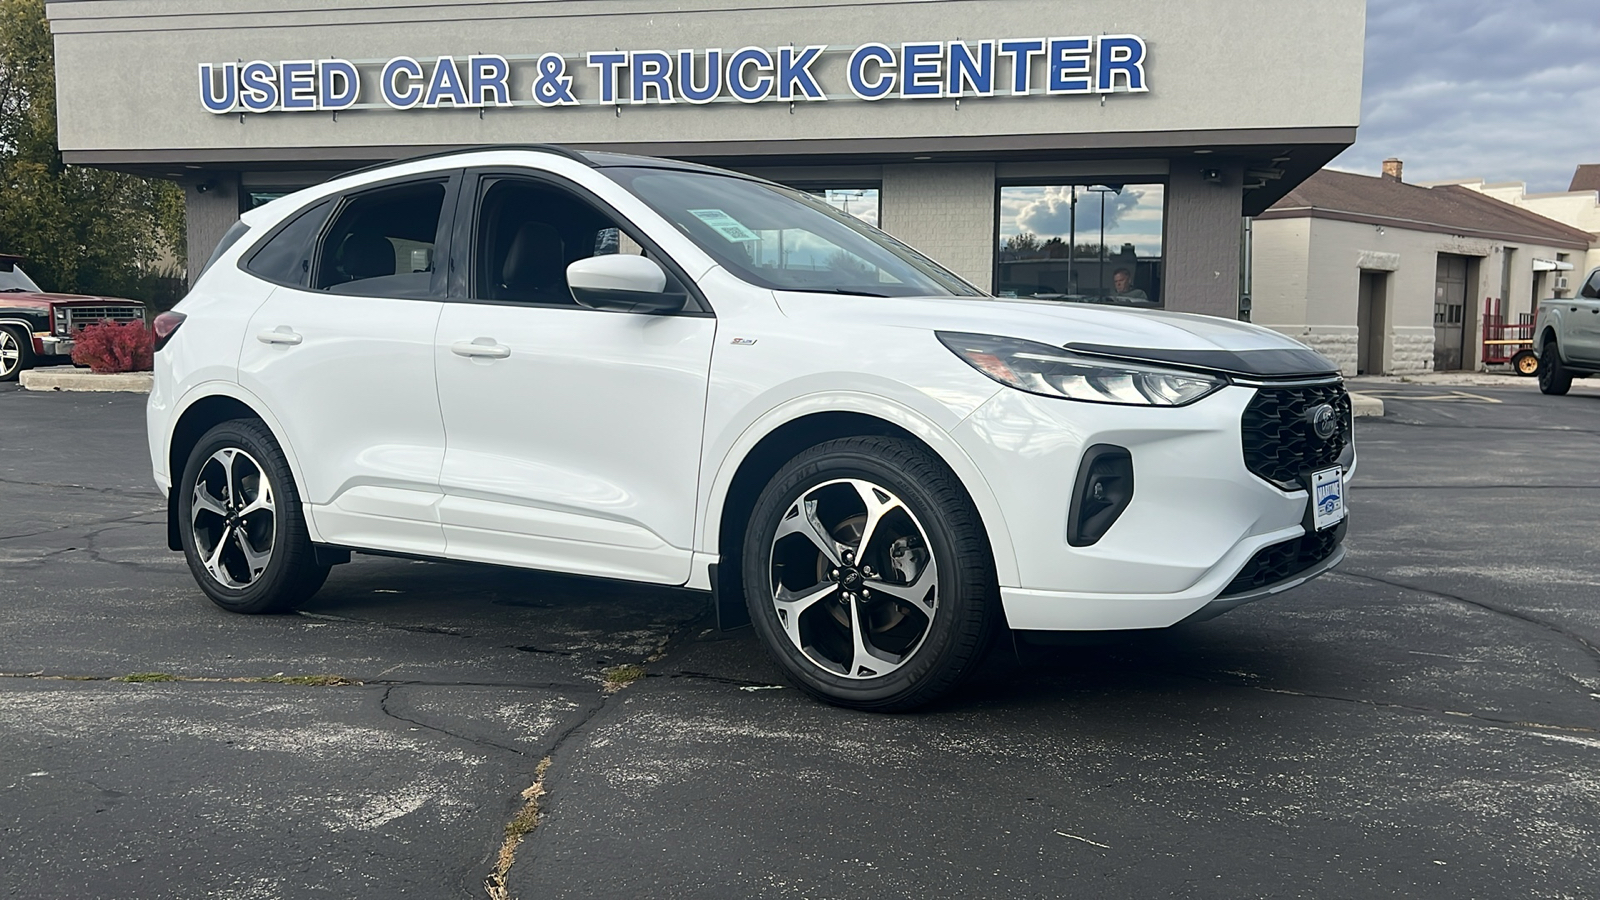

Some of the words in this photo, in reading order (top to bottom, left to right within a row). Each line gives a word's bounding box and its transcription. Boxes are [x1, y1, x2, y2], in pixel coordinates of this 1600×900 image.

[198, 60, 360, 114] USED
[380, 54, 511, 110] CAR
[531, 52, 579, 107] &
[587, 45, 828, 105] TRUCK
[846, 34, 1150, 101] CENTER
